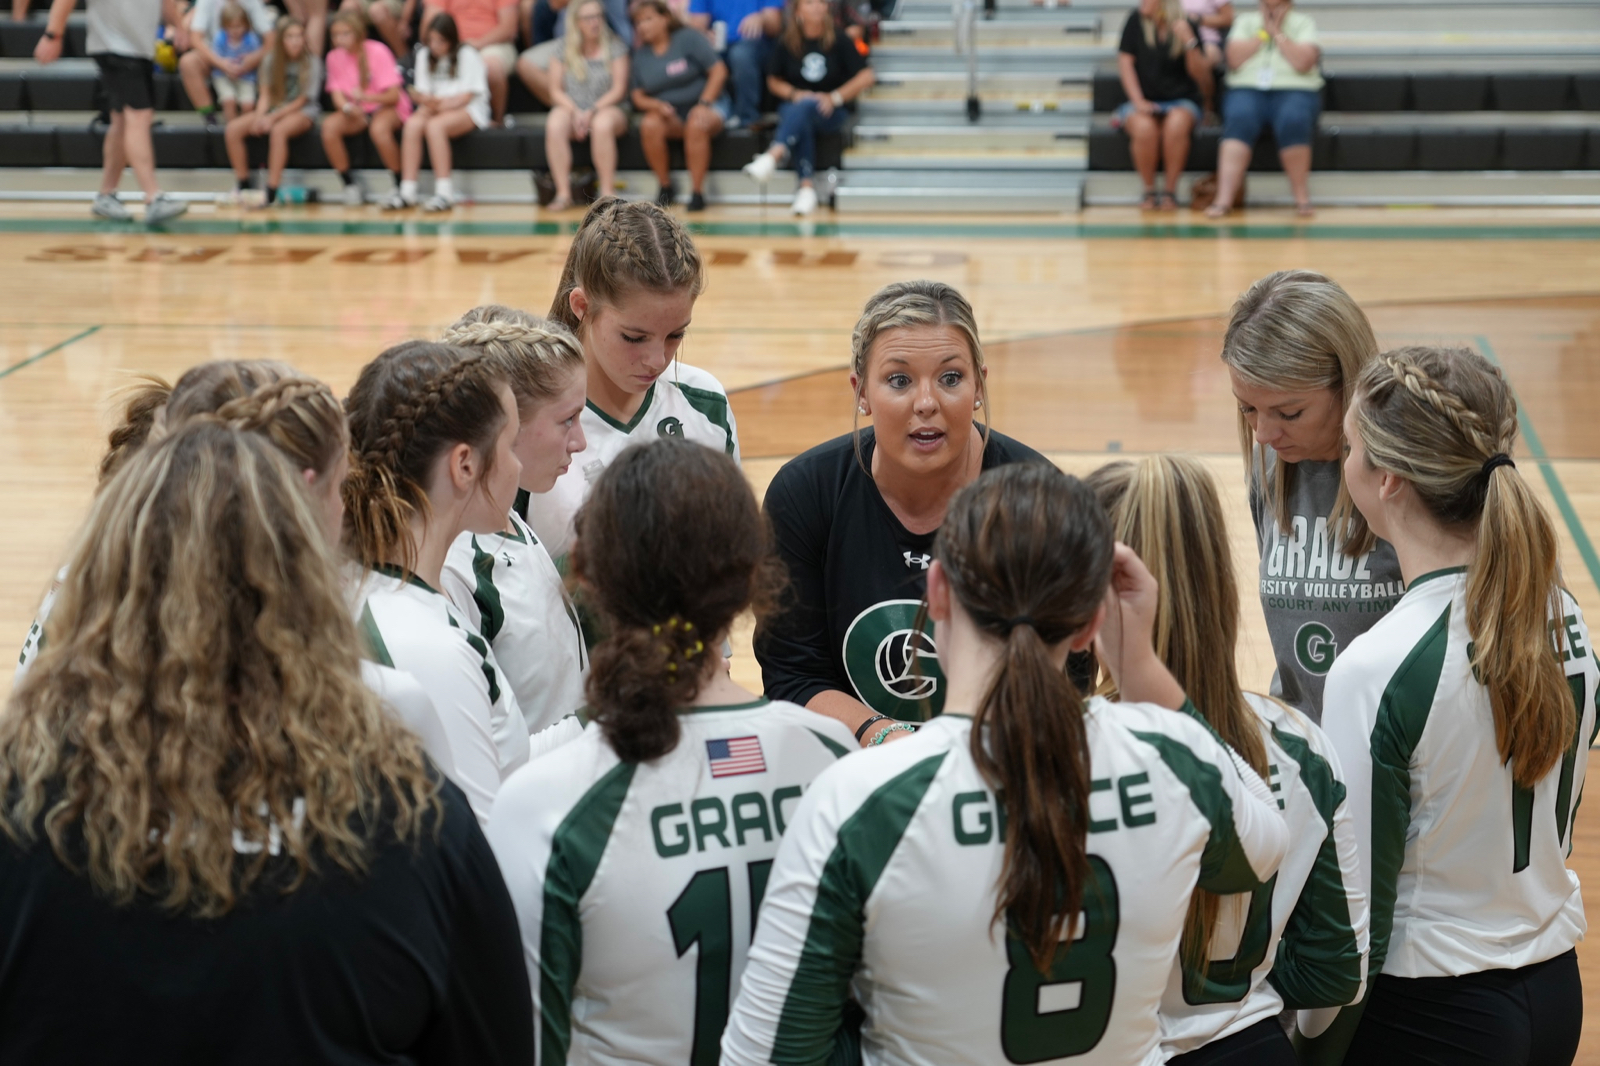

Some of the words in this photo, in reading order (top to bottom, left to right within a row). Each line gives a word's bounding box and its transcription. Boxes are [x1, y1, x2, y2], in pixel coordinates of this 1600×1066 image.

[1268, 597, 1317, 611] COURT.
[1322, 600, 1351, 613] ANY
[1304, 580, 1407, 599] VOLLEYBALL
[1294, 621, 1337, 677] G
[650, 783, 812, 859] GRAC
[952, 771, 1156, 846] GCE
[1000, 853, 1120, 1065] 8
